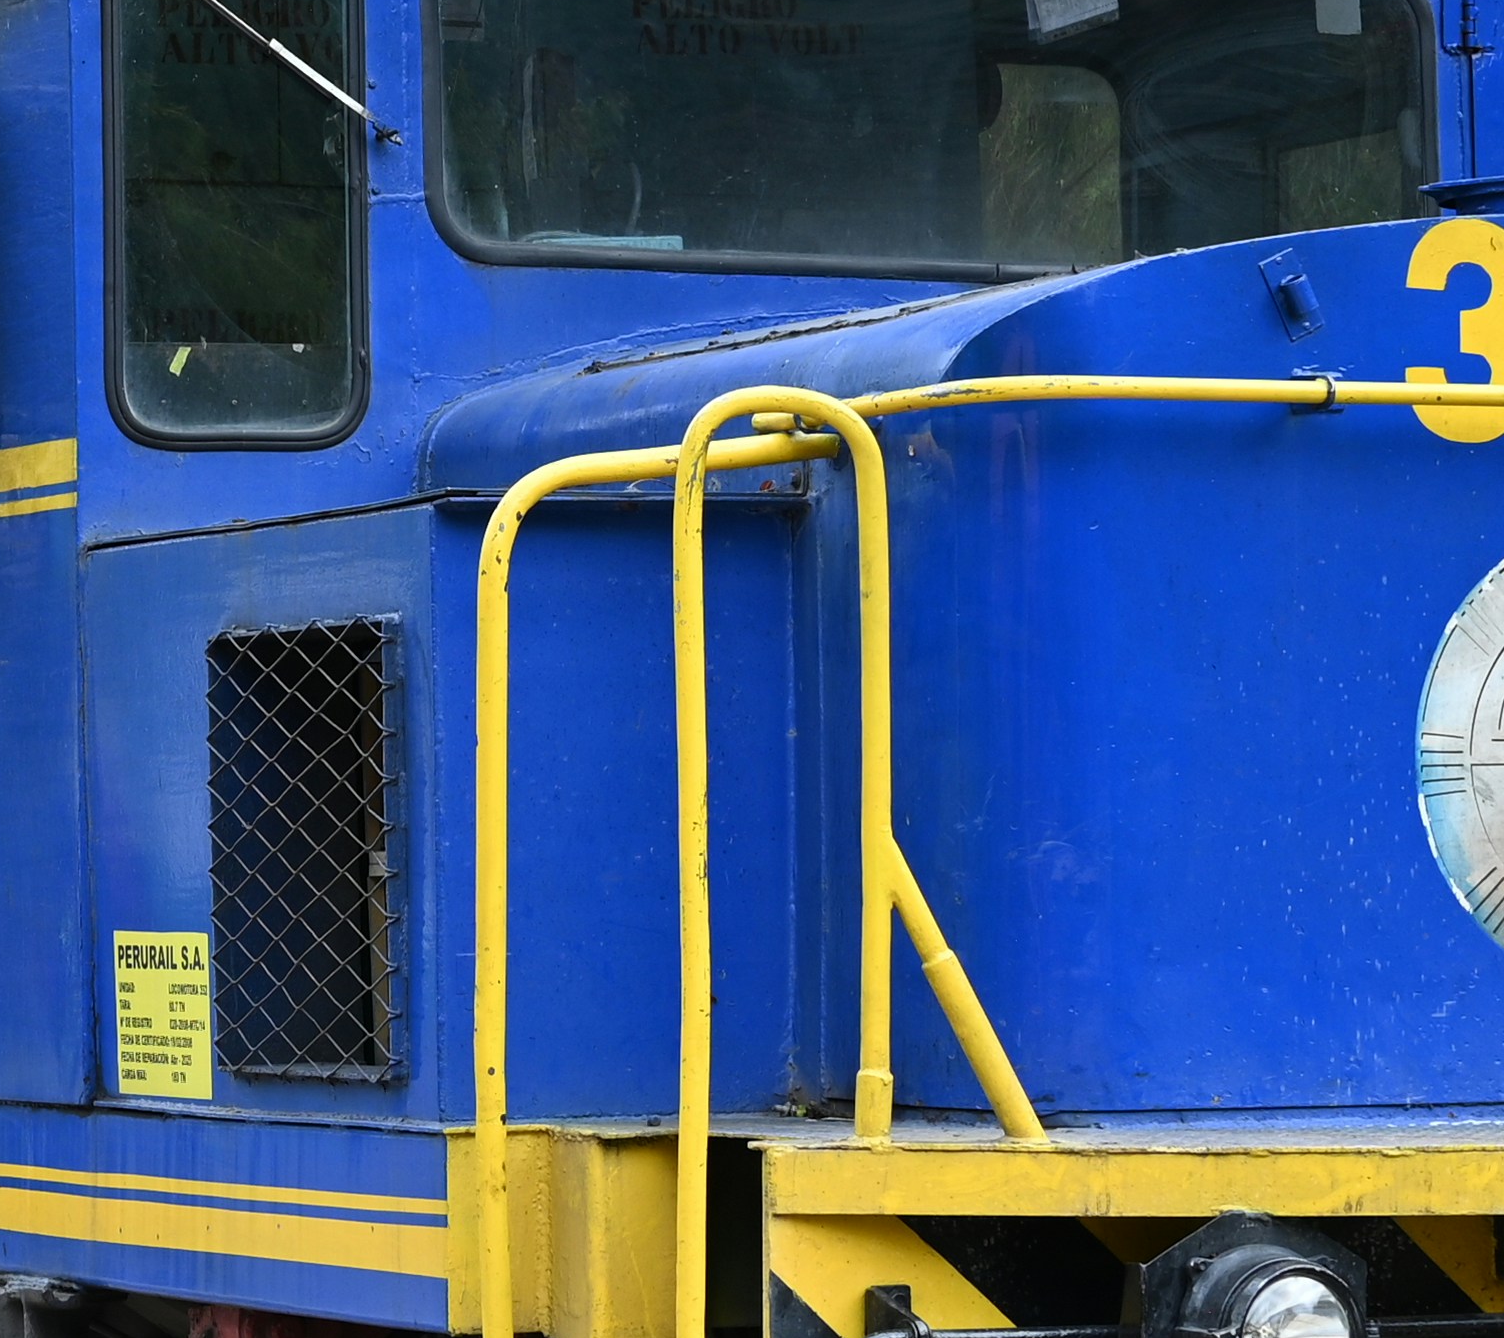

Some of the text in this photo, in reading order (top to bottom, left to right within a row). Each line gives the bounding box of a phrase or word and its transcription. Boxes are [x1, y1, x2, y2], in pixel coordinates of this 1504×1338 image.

[637, 23, 742, 55] ALTO
[118, 945, 205, 971] PERURAIL S.A.
